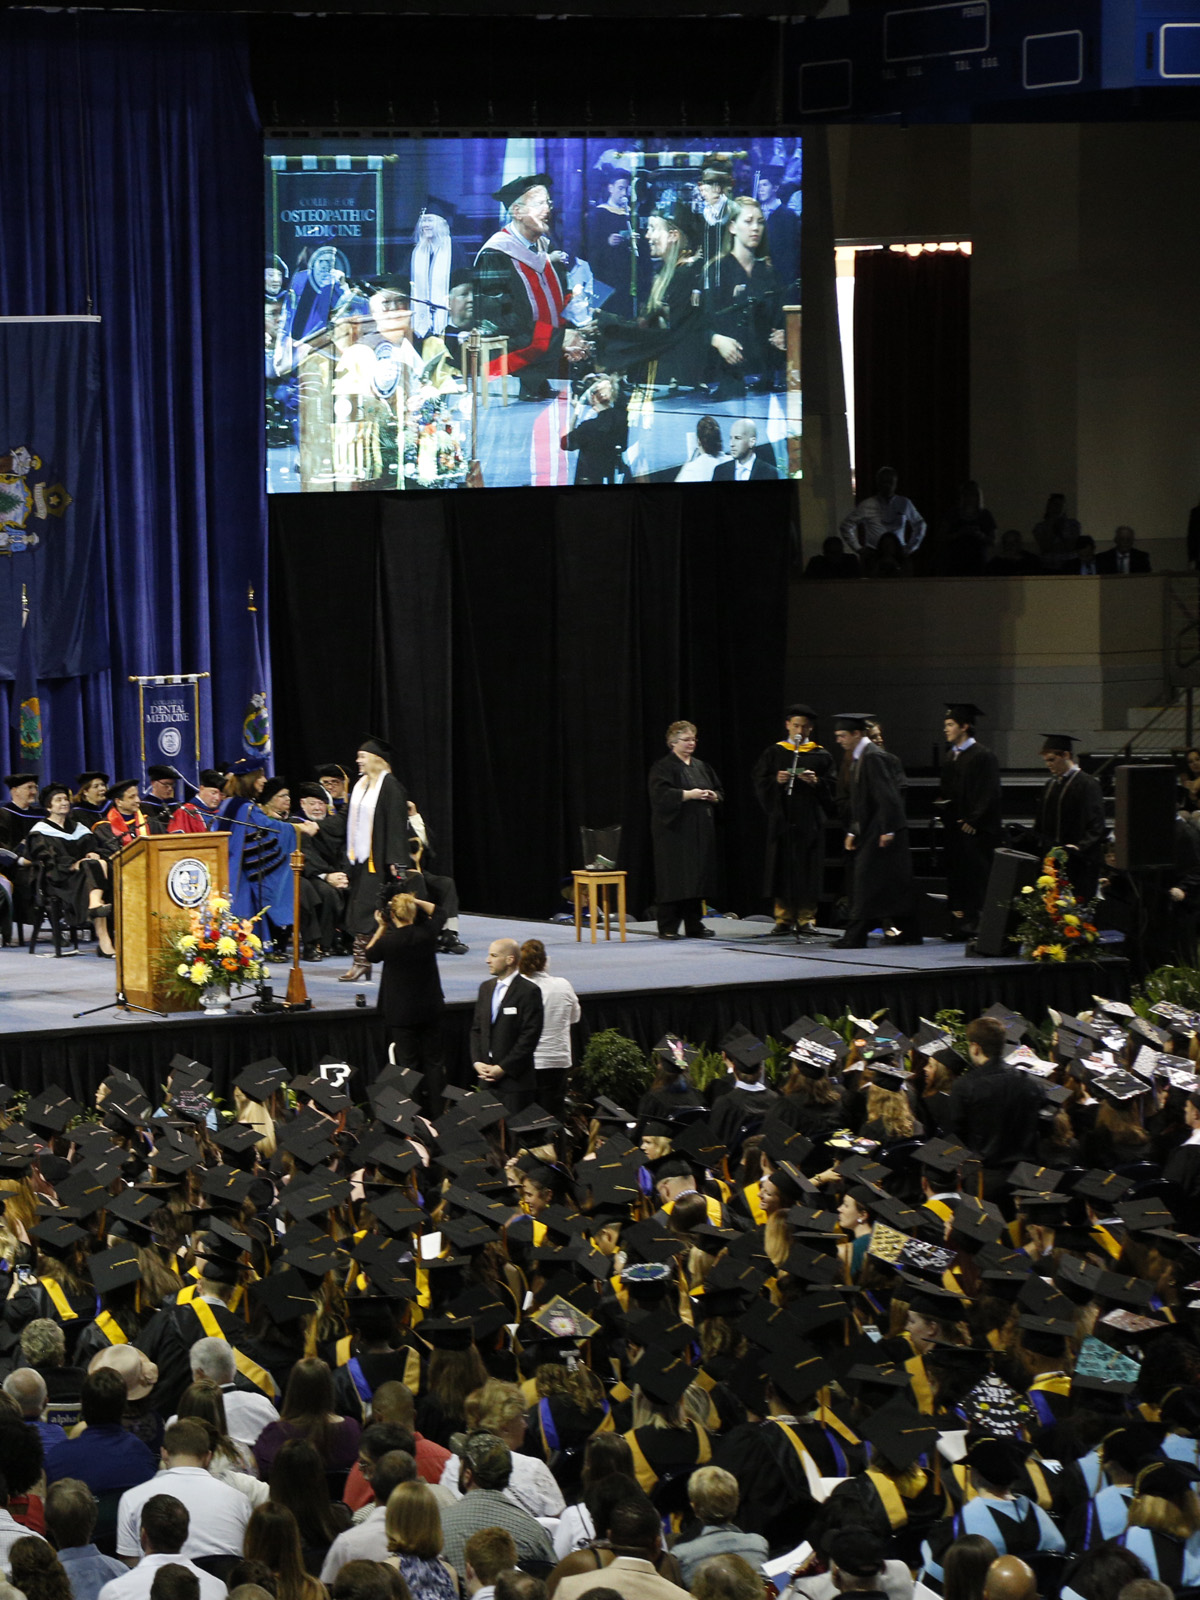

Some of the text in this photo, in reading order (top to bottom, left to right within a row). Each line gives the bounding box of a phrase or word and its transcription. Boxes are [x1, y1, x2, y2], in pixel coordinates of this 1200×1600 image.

[298, 198, 340, 207] COLLEE
[281, 209, 375, 222] OSTEOPATHIC
[295, 225, 362, 238] MEDICINE
[150, 704, 186, 714] DENTAL
[146, 713, 190, 723] MEDICINE
